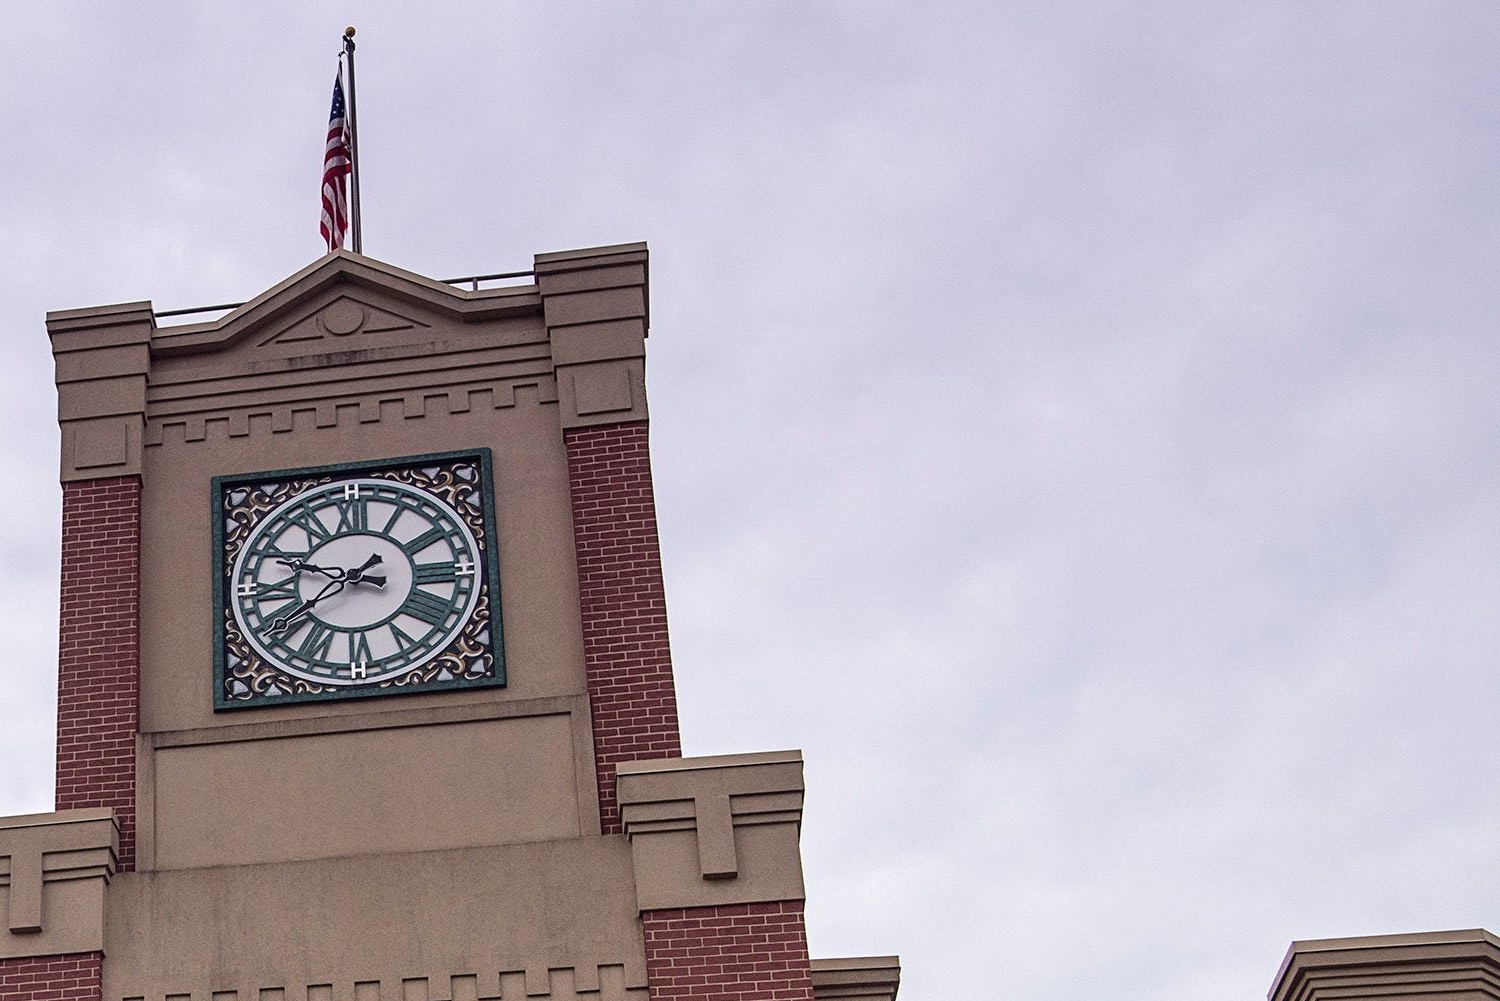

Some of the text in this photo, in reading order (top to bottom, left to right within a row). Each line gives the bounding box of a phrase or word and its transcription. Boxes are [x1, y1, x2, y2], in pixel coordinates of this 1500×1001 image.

[335, 500, 368, 535] XII
[403, 523, 446, 555] II
[414, 560, 456, 584] III
[297, 620, 336, 662] VII
[348, 629, 373, 664] VI
[387, 620, 421, 655] V
